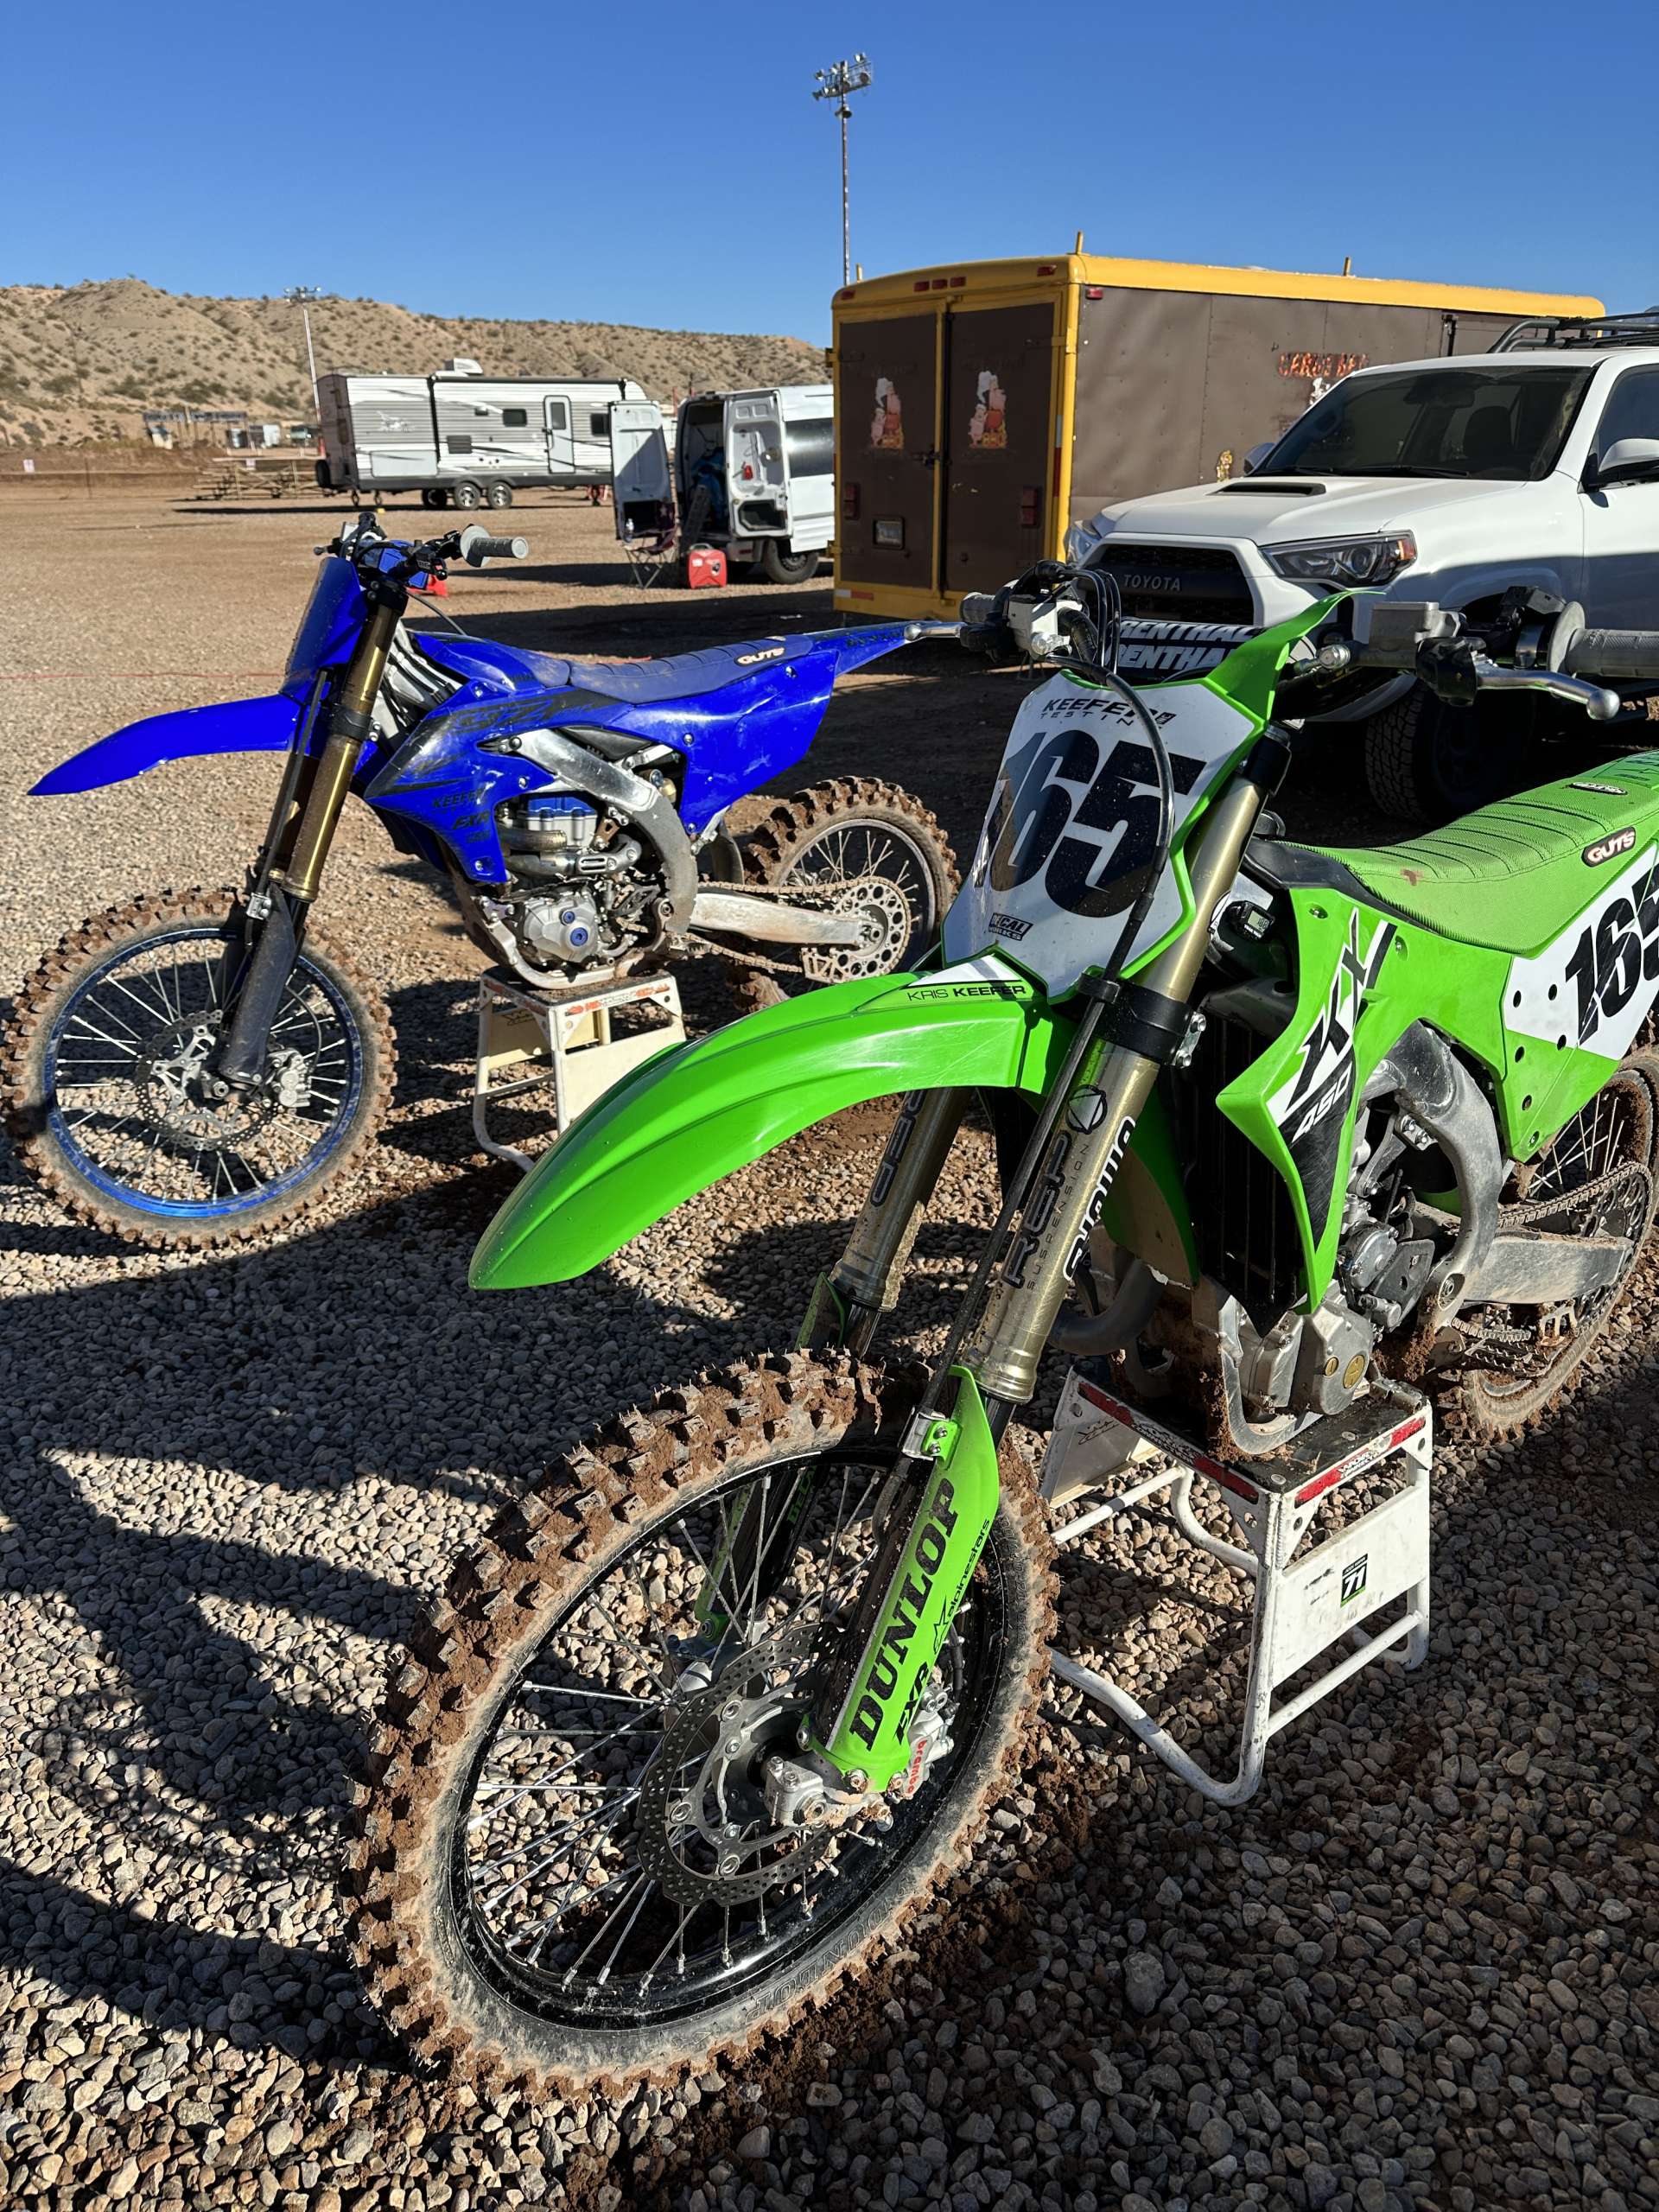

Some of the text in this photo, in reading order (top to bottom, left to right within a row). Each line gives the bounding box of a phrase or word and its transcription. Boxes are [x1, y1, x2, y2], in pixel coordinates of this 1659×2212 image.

[1123, 575, 1181, 591] TOYOTA
[1120, 620, 1254, 642] RENTHAL
[737, 647, 785, 664] GUTS
[1105, 644, 1243, 671] RENTHA
[974, 728, 1206, 918] 165
[1587, 830, 1636, 863] GUTS
[907, 985, 1027, 1001] KRIS KEEFER
[1294, 1072, 1350, 1142] 450
[1027, 1144, 1090, 1289] SUSPENSION
[947, 1518, 990, 1618] alpinestars
[1342, 1566, 1366, 1599] 71
[849, 1478, 961, 1751] DUNLOP
[893, 1662, 930, 1745] FXR
[907, 1737, 929, 1796] brembo
